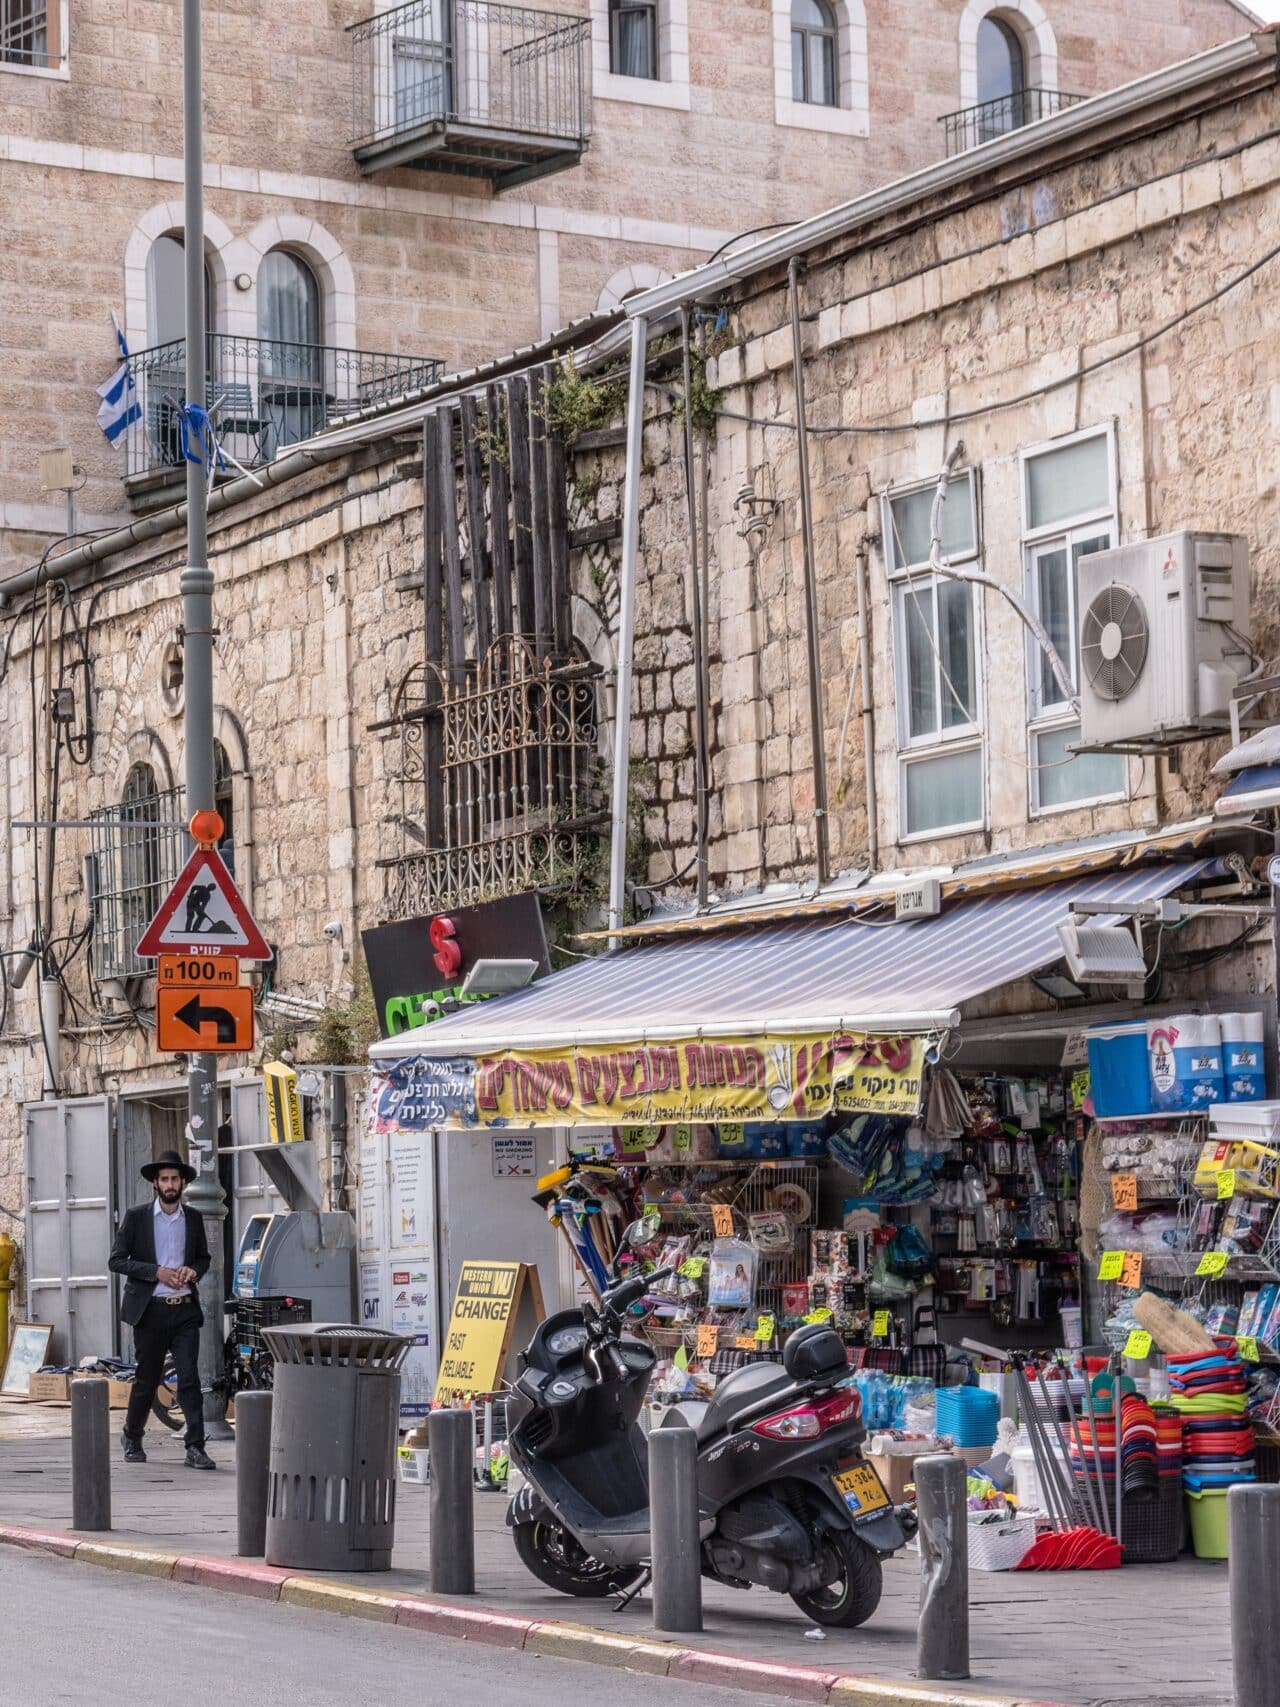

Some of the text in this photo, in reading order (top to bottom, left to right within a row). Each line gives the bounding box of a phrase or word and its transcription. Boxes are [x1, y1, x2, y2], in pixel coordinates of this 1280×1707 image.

[177, 961, 215, 981] 100
[219, 970, 232, 981] m
[575, 1045, 680, 1105] ומבצעים
[684, 1043, 765, 1088] הנחות
[424, 1083, 439, 1097] חד
[442, 1078, 464, 1097] כלים
[861, 1075, 896, 1097] ניקוי
[495, 1139, 513, 1148] לעשן
[463, 1268, 493, 1281] WESTERN
[469, 1281, 491, 1294] UNION
[455, 1299, 510, 1321] CHANGE
[449, 1332, 467, 1351] FAST
[442, 1360, 475, 1379] RELIABLE
